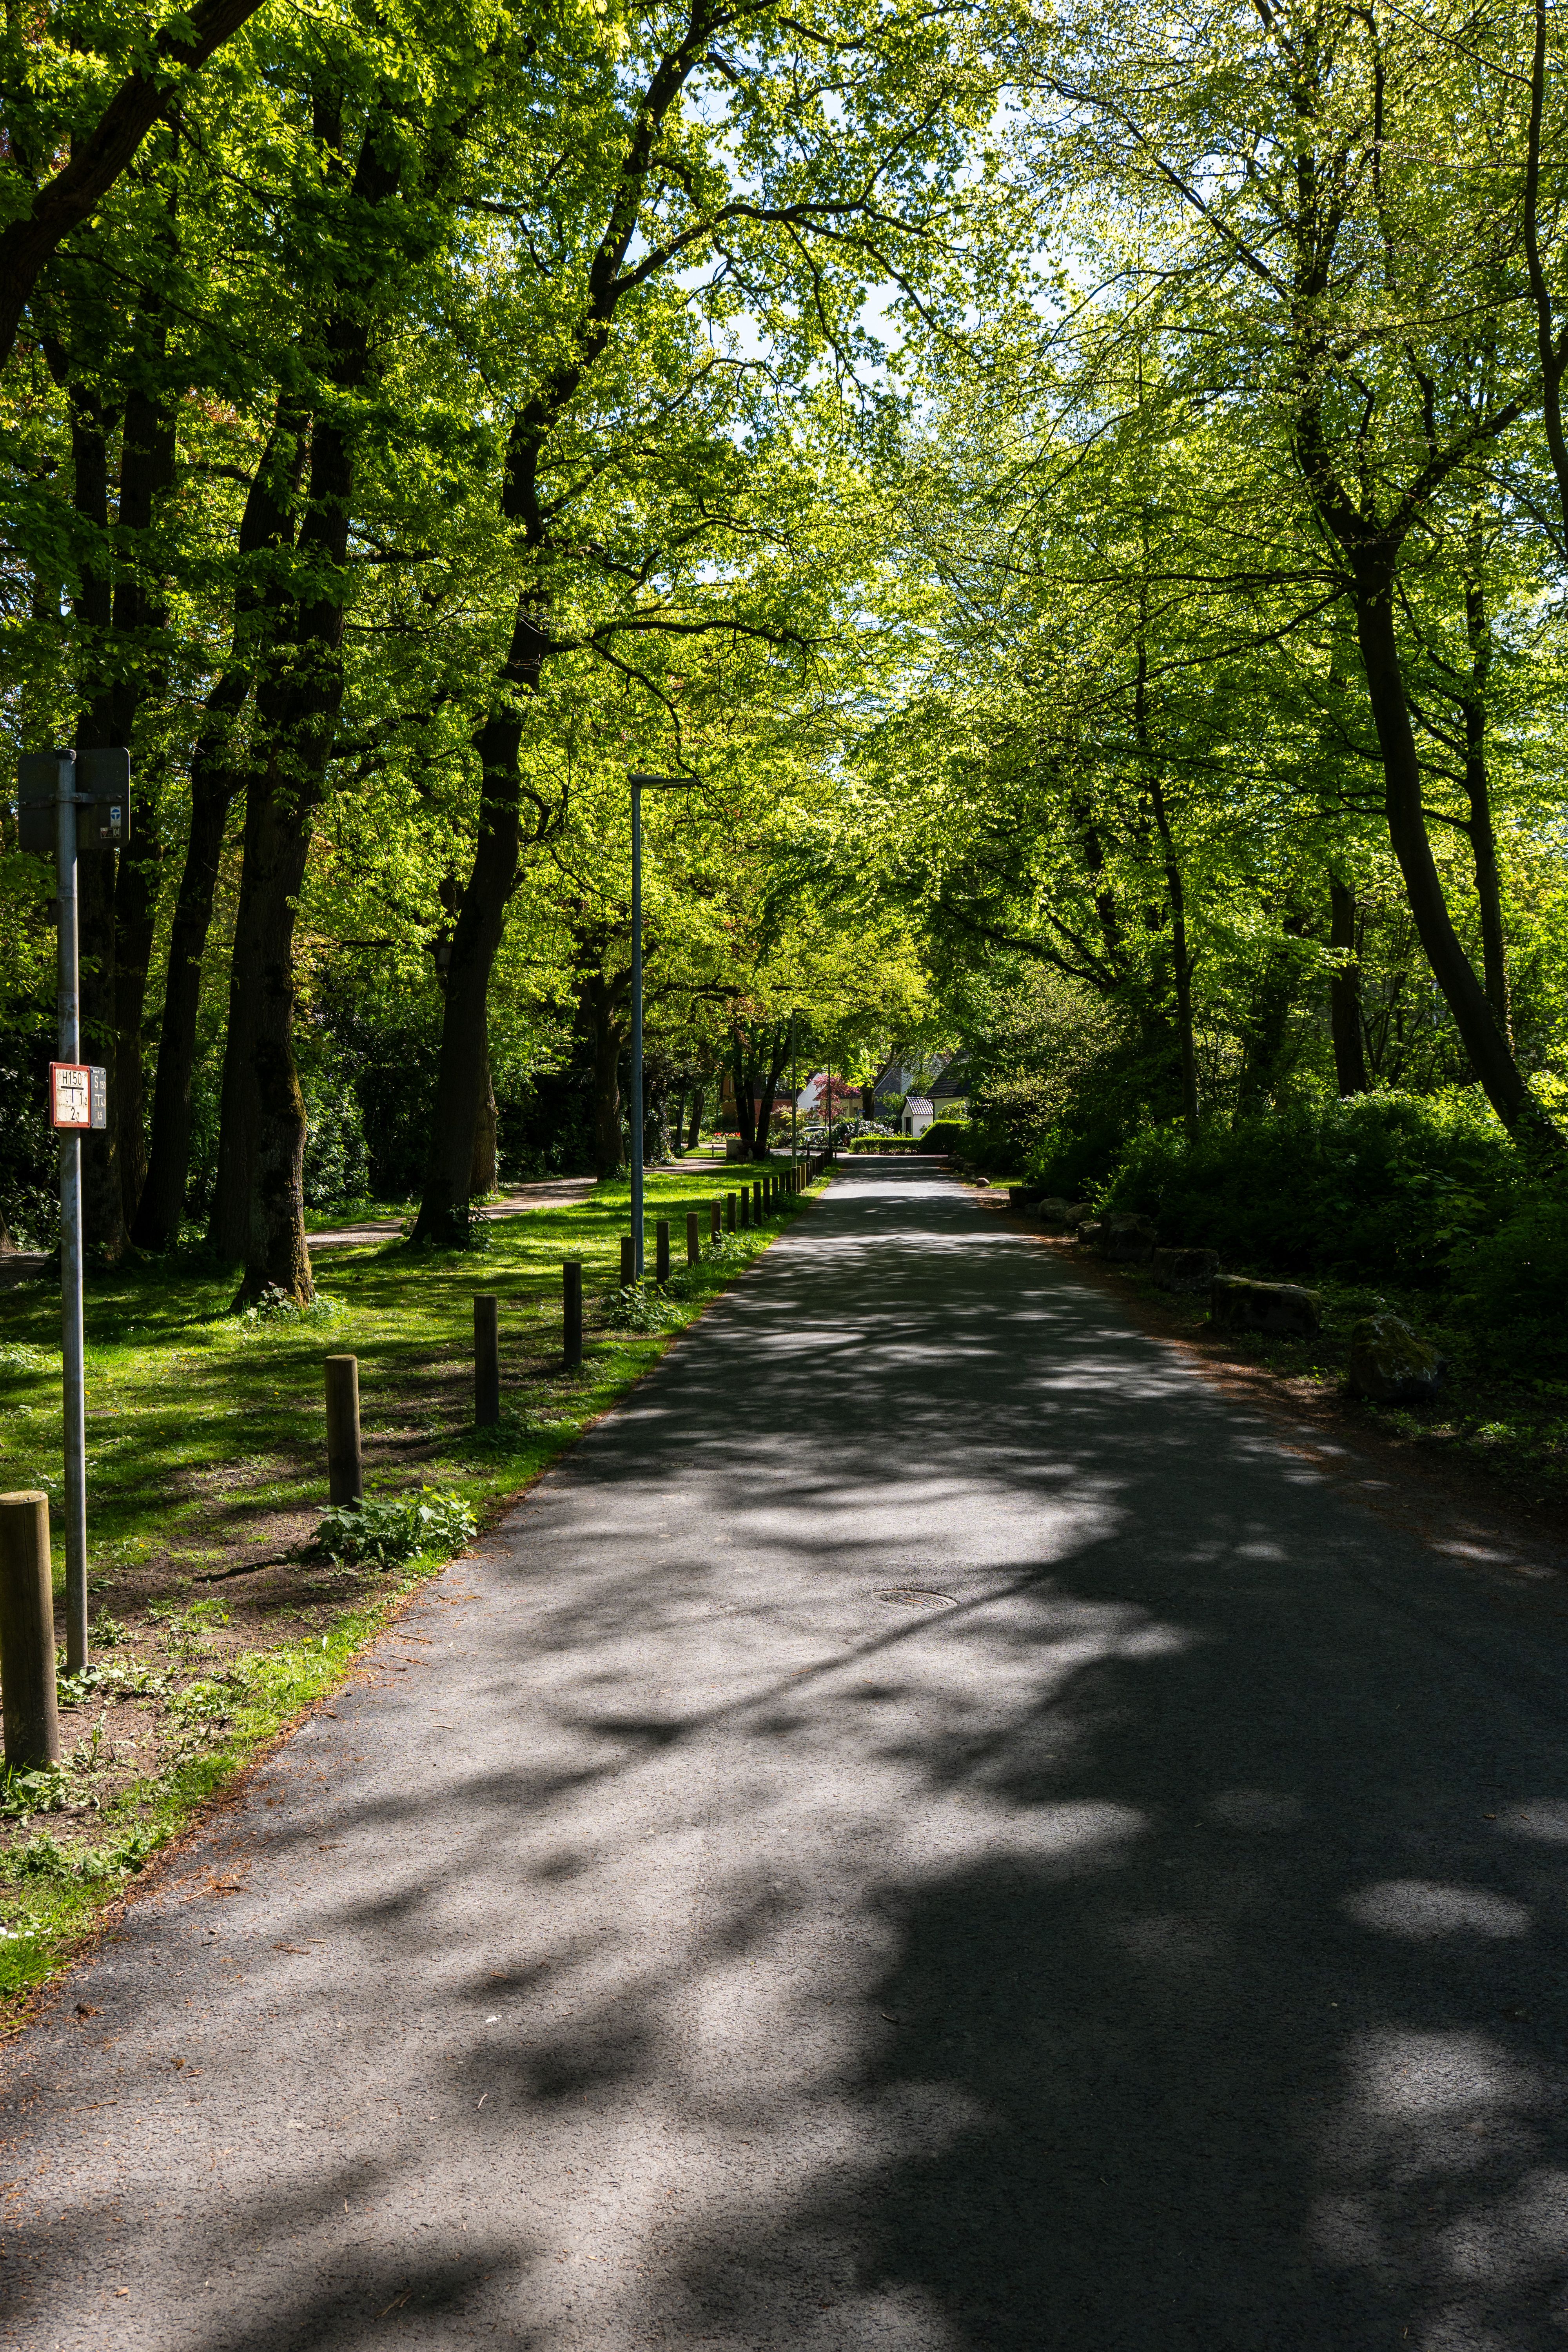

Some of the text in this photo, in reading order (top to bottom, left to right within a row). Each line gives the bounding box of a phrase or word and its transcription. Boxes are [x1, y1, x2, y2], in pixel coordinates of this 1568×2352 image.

[114, 828, 120, 836] 04
[62, 1071, 82, 1085] H150
[94, 1075, 98, 1088] S
